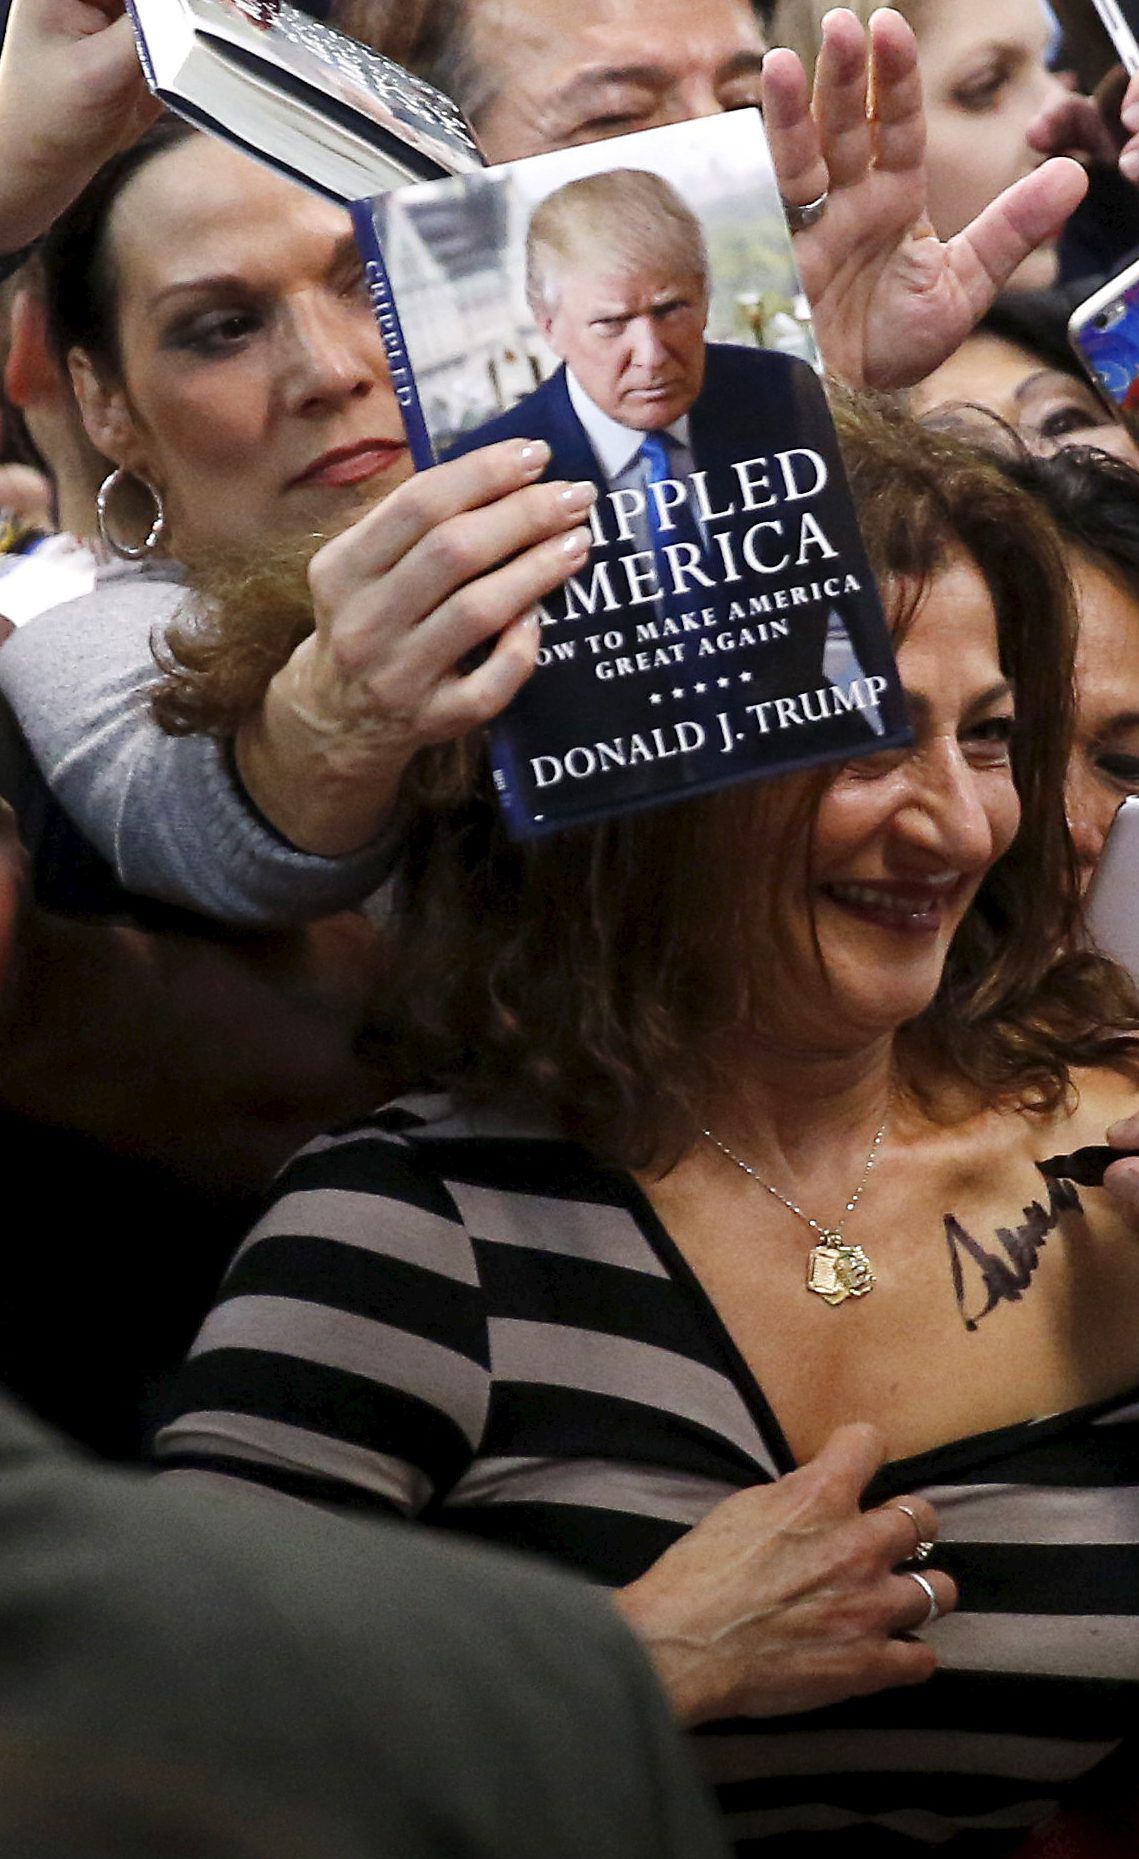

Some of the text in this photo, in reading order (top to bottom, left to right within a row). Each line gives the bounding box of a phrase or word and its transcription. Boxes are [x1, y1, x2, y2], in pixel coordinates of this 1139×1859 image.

[586, 447, 828, 547] IPPLED
[536, 573, 861, 667] OW TO MAKE AMERICA
[595, 618, 791, 681] GREAT AGAIN
[530, 720, 706, 788] DONALD
[716, 712, 746, 753] J.
[746, 675, 888, 735] TRUMP
